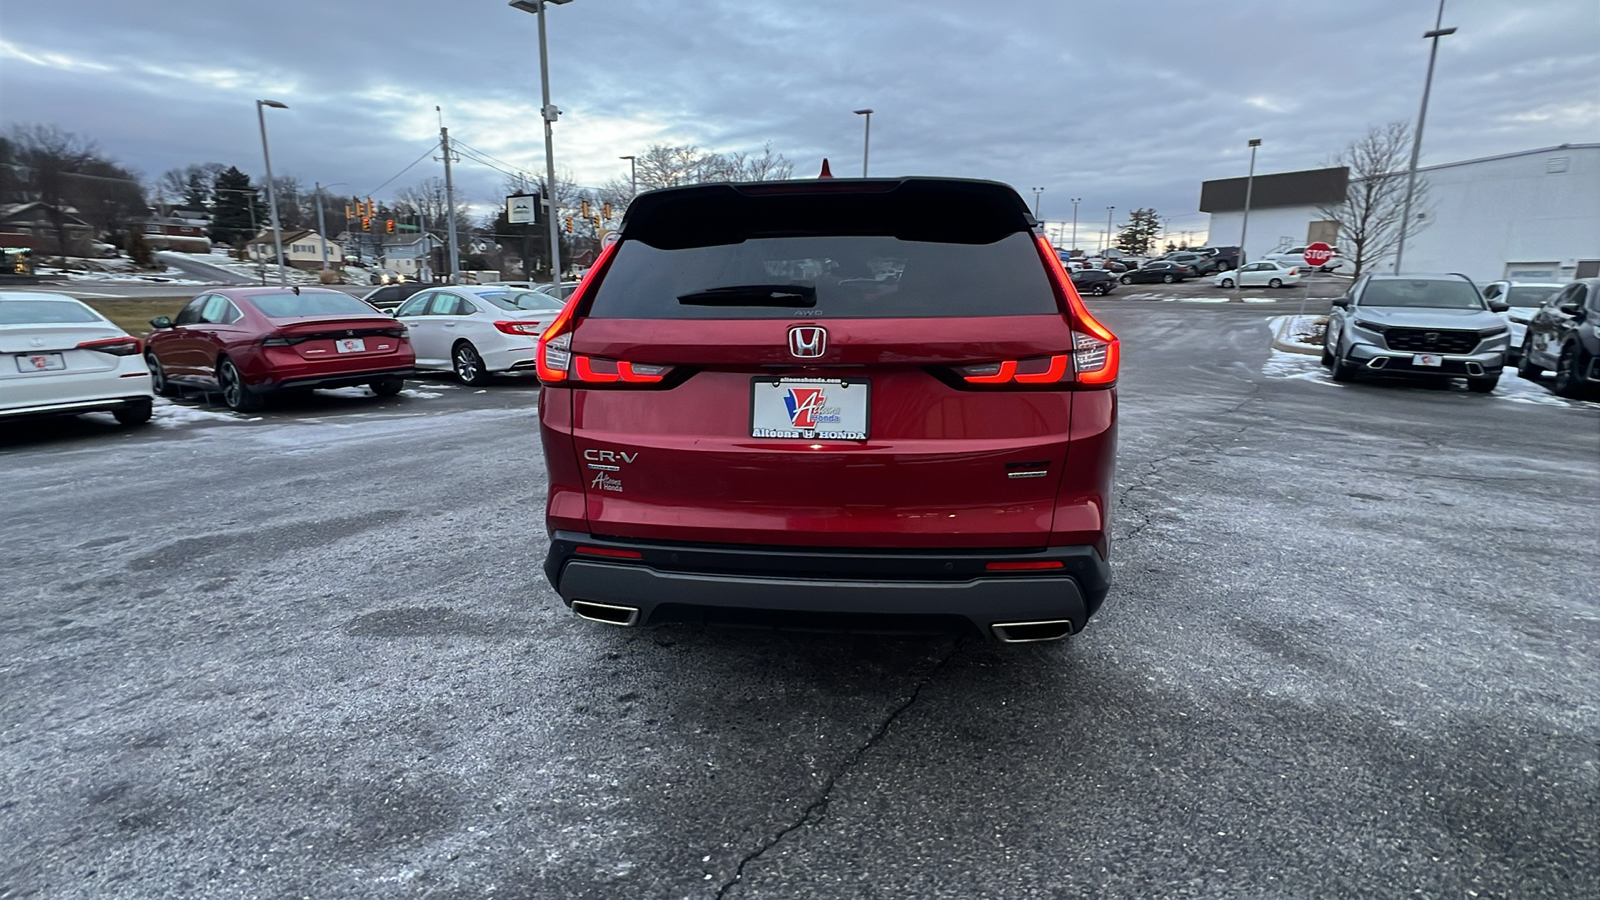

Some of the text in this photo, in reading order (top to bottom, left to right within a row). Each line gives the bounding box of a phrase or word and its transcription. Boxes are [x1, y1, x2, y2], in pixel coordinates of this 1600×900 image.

[1304, 249, 1331, 260] STOP
[811, 414, 840, 422] Honda
[752, 428, 799, 438] Altoona
[818, 431, 867, 440] HONDA
[584, 449, 639, 463] CR-V
